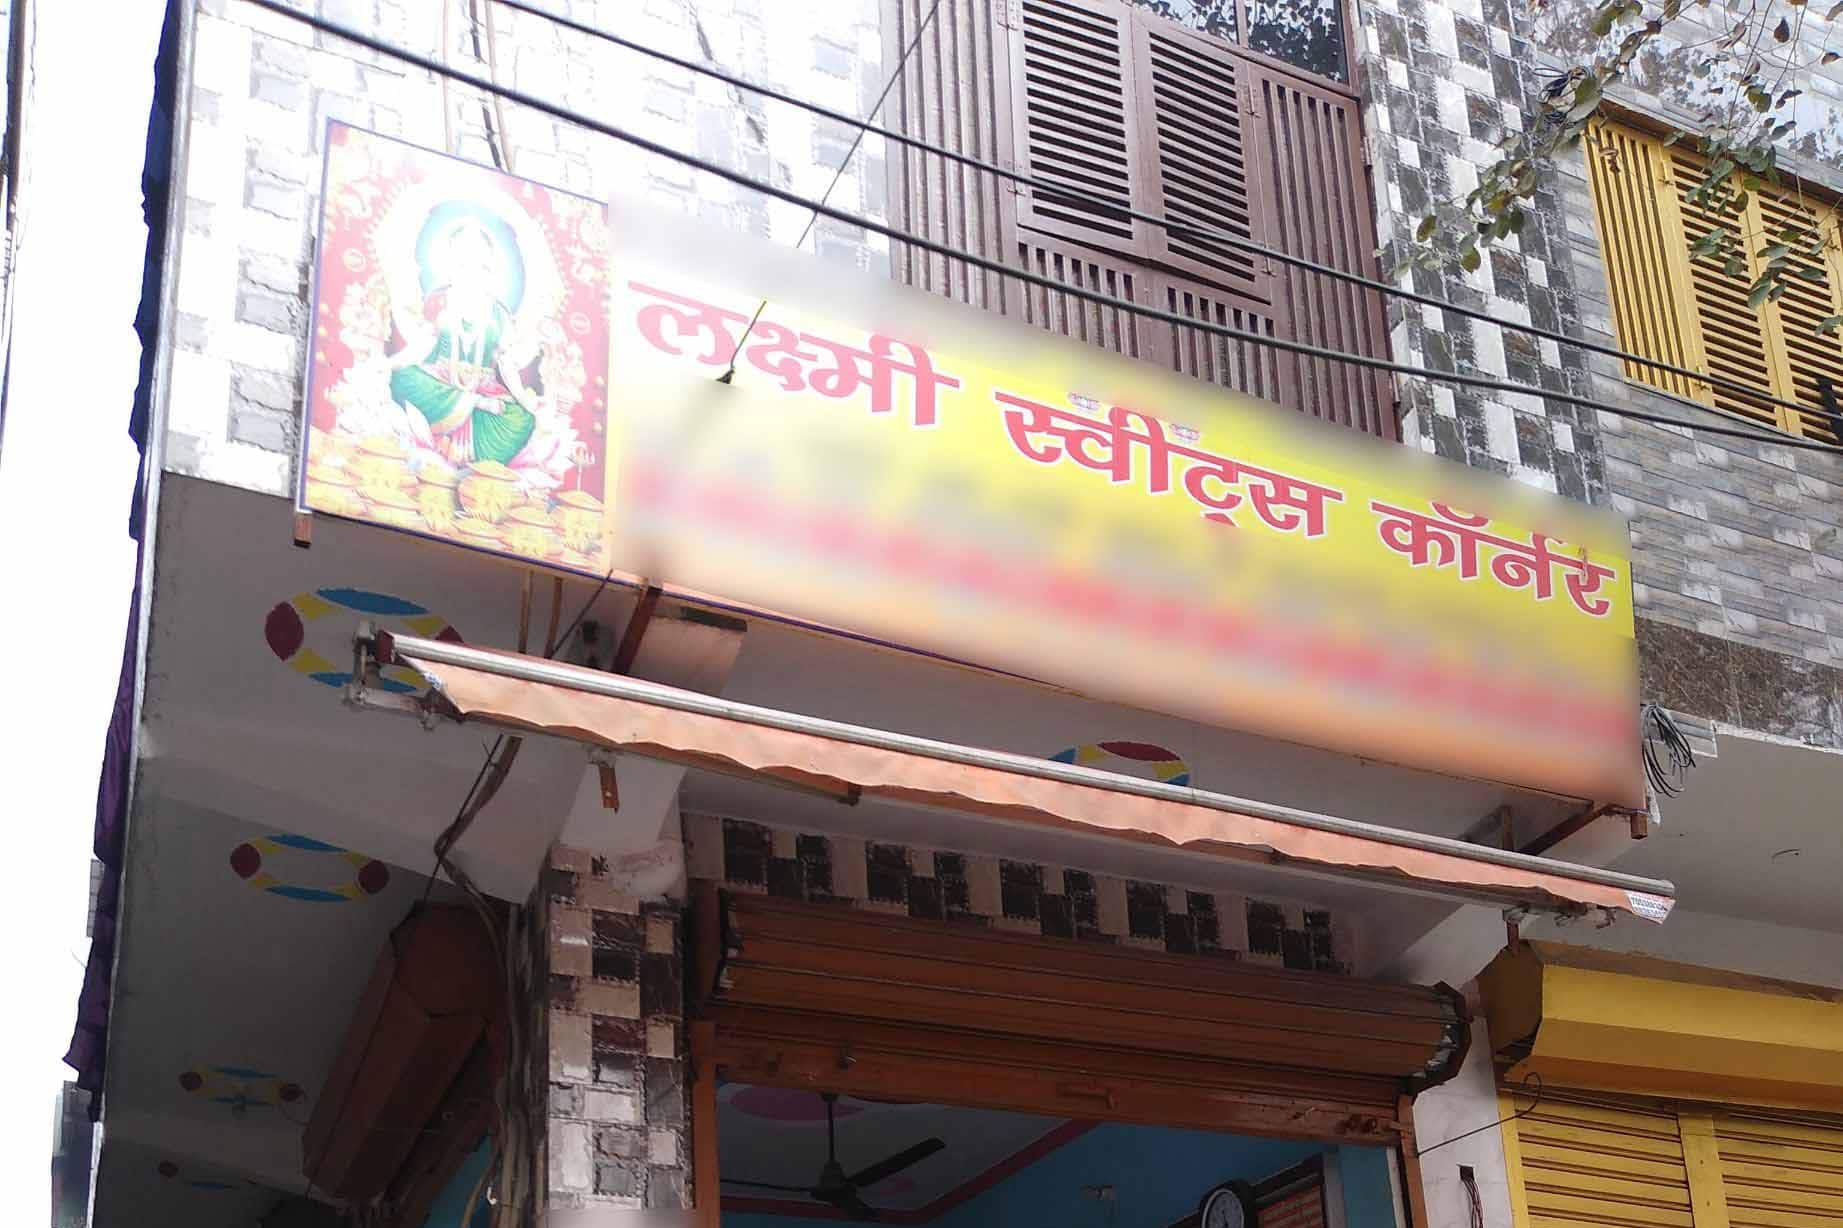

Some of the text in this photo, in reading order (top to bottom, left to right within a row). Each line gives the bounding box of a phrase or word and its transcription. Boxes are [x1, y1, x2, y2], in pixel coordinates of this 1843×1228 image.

[627, 280, 1616, 617] लक्ष्मी स्वीट्स कॉर्नर
